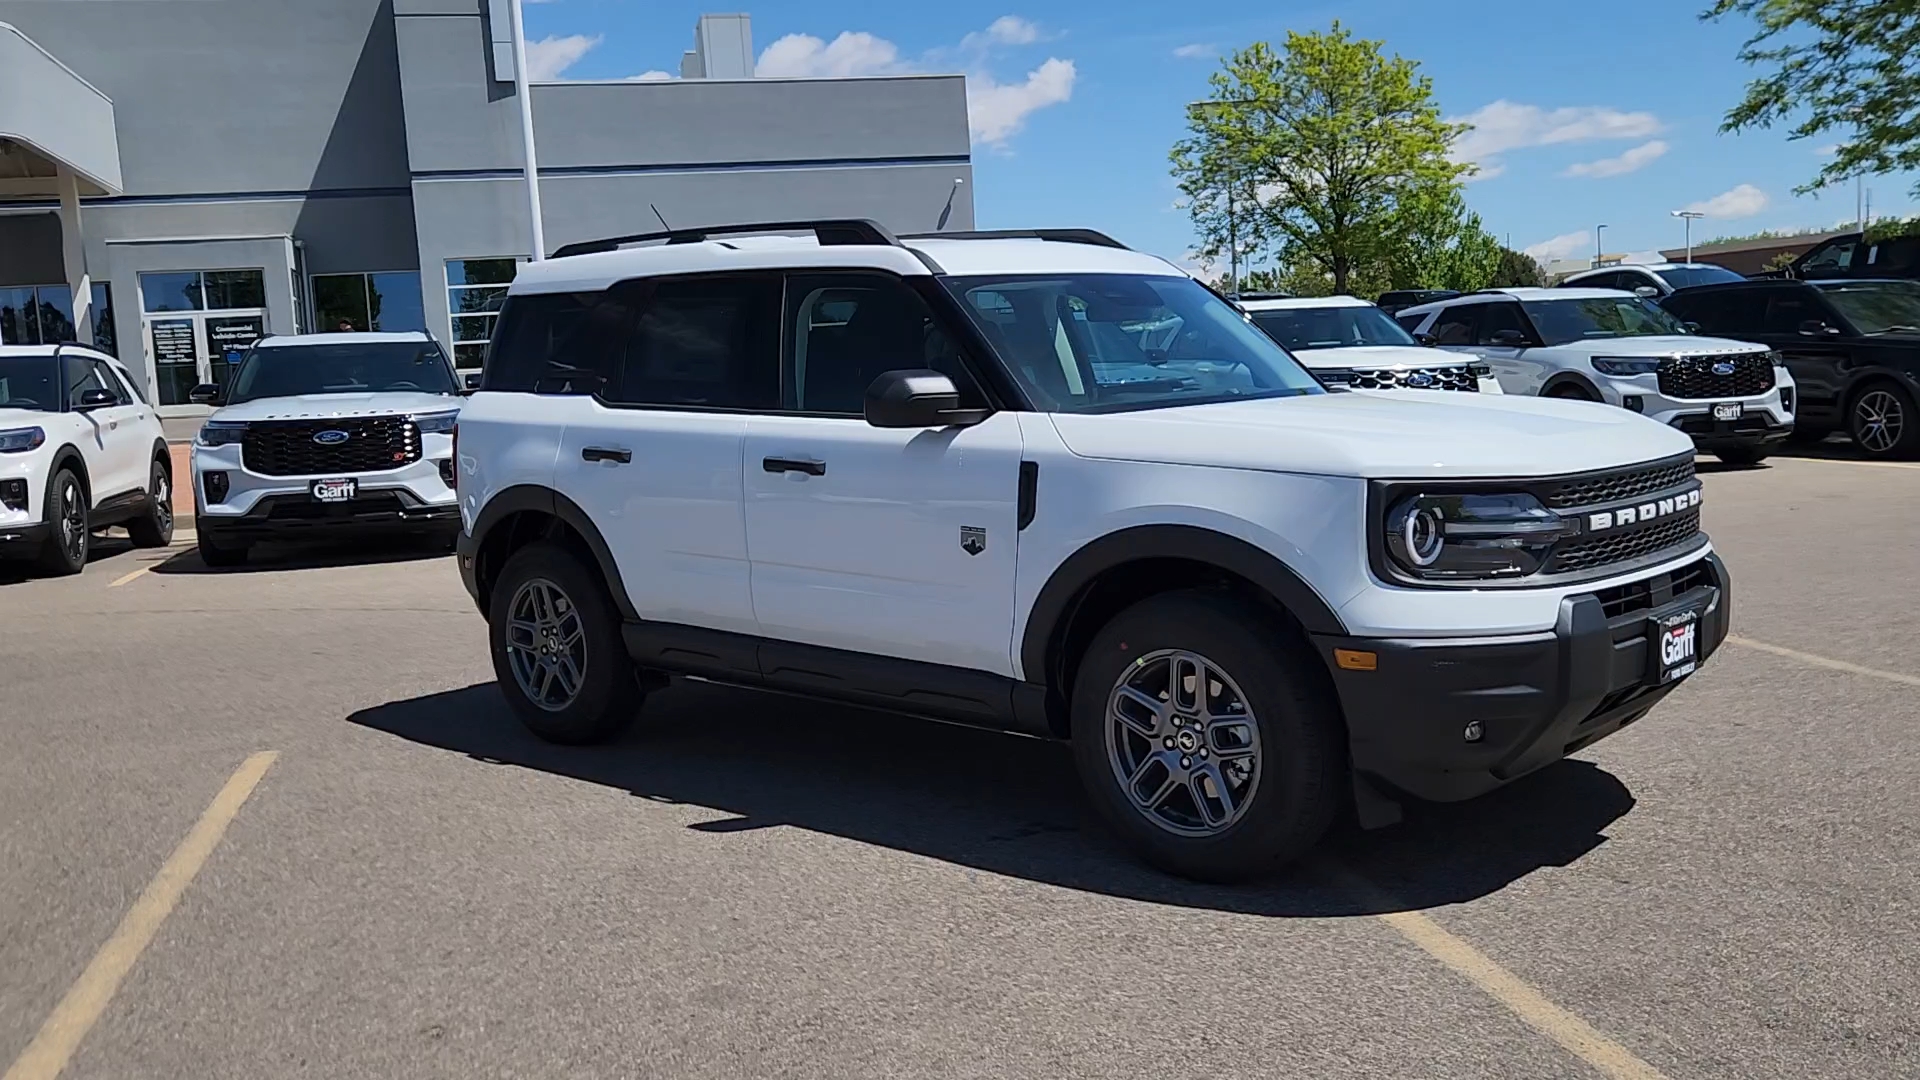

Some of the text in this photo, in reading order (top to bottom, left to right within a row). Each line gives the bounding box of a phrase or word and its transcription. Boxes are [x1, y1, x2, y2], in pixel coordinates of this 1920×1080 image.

[215, 324, 253, 332] Commercial
[1714, 405, 1741, 417] Garff
[313, 482, 355, 499] Garff
[1589, 489, 1700, 531] BRONCO
[1661, 622, 1695, 665] Garff
